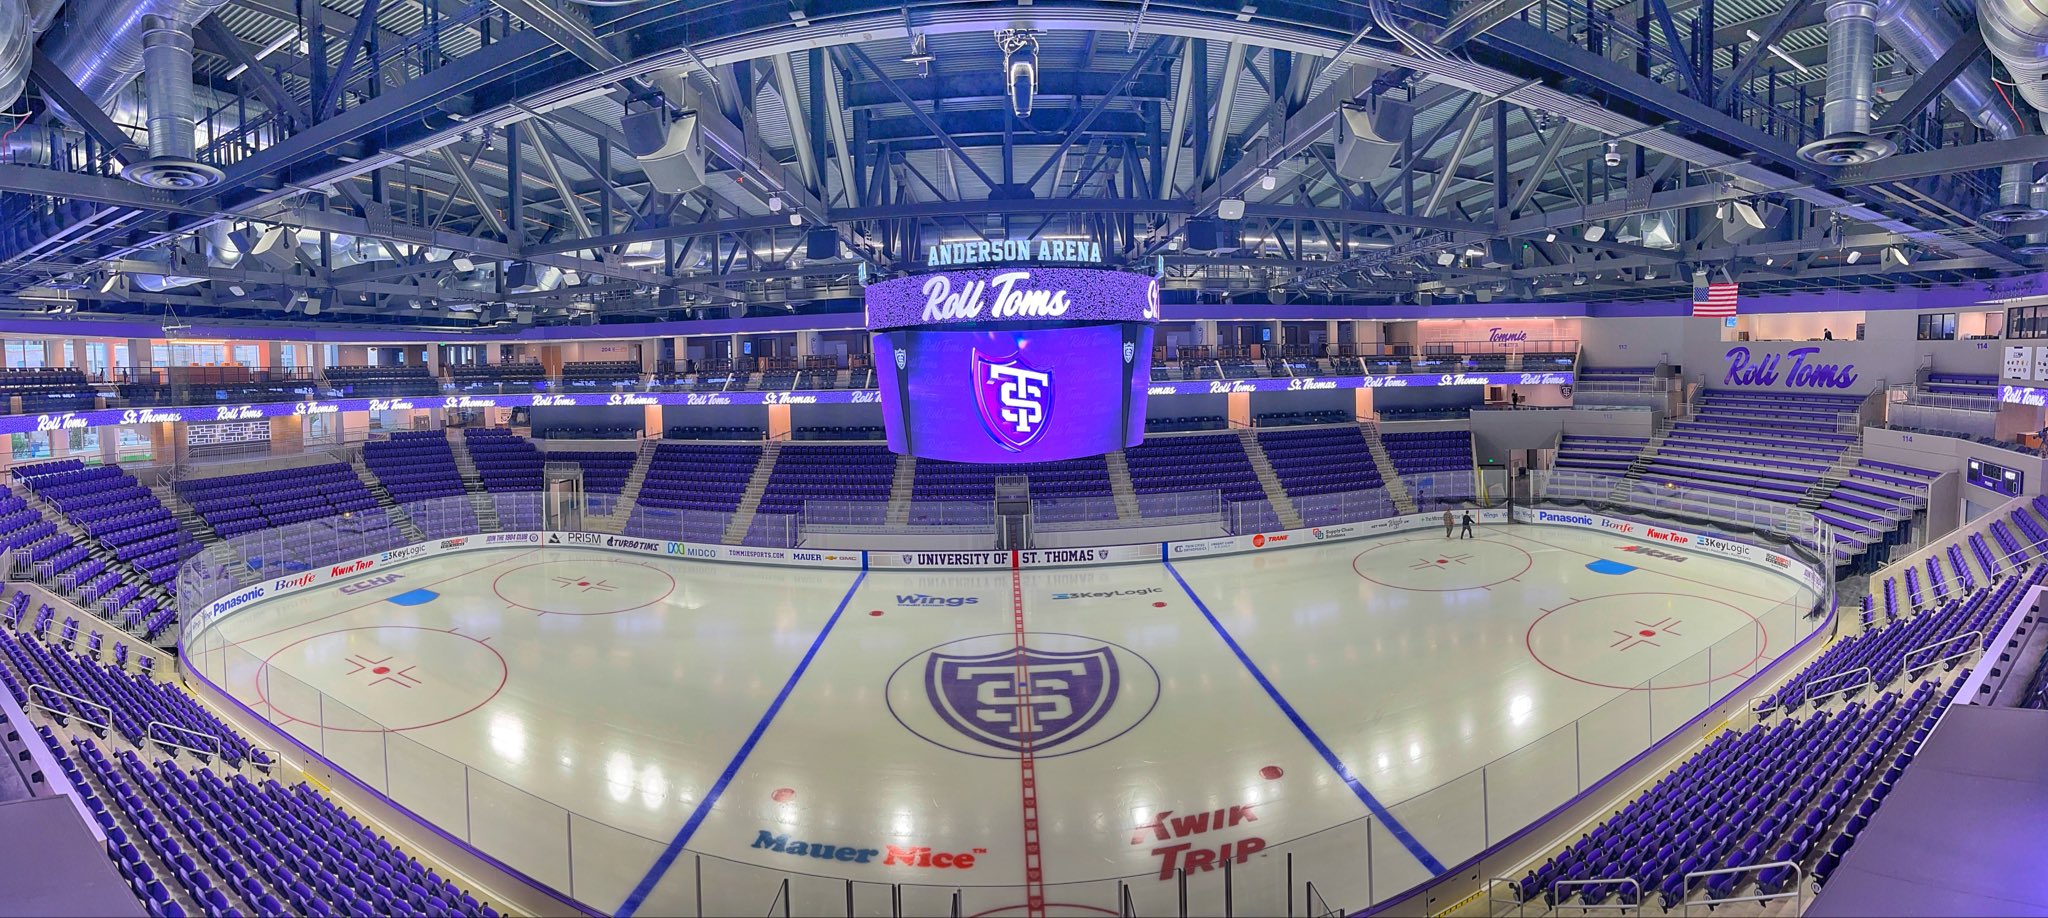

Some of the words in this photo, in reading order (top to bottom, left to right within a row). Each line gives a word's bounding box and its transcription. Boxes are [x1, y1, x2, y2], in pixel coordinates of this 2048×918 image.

[928, 240, 1031, 267] ANDERSON
[1038, 240, 1101, 263] ARENA
[922, 275, 985, 321] Roll
[991, 272, 1071, 318] Toms
[1490, 328, 1527, 342] Tommie
[1724, 347, 1780, 386] Roll
[1786, 347, 1858, 388] Toms
[1302, 378, 1337, 390] Thomas
[1364, 376, 1384, 387] Roll
[1384, 375, 1407, 387] Toms
[1452, 374, 1489, 385] Thomas
[1520, 374, 1540, 385] Roll
[1540, 373, 1565, 385] Toms
[1148, 385, 1176, 395] omas
[1210, 381, 1230, 393] Roll
[1231, 381, 1256, 393] Toms
[532, 395, 553, 406] Roll
[553, 395, 576, 406] Toms
[622, 393, 659, 405] Thomas
[688, 393, 707, 405] Roll
[707, 393, 731, 405] Toms
[777, 393, 817, 404] Thomas
[852, 391, 872, 403] Roll
[2003, 385, 2022, 403] Roll
[2022, 387, 2046, 406] Toms
[306, 402, 339, 414] Thomas
[369, 399, 389, 412] Roll
[390, 399, 414, 411] Toms
[459, 396, 496, 408] Thomas
[139, 408, 182, 423] Thomas
[217, 406, 238, 421] Roll
[239, 405, 263, 419] Toms
[37, 414, 61, 432] Roll
[62, 413, 88, 429] Toms
[1540, 512, 1592, 525] Panasonic
[1601, 518, 1634, 533] Bonfe
[568, 533, 601, 544] PRISM
[614, 539, 638, 549] TURBO
[1670, 532, 1688, 544] TRIP
[389, 544, 426, 560] 3KeyLogic
[1705, 538, 1749, 554] 3KeyLogic
[688, 548, 716, 558] MIDCO
[729, 550, 784, 559] TOMMIESPORTS.COM
[793, 553, 822, 561] MAUER
[917, 553, 989, 565] UNIVERSITY
[994, 553, 1009, 565] OF
[1022, 553, 1041, 564] ST.
[1045, 549, 1094, 563] THOMAS
[355, 560, 374, 571] TRIP
[274, 572, 316, 591] Bonfe
[339, 573, 405, 593] CCHA
[1070, 587, 1163, 599] 3KeyLogic
[214, 586, 265, 616] Panasonic
[896, 594, 979, 607] Wings
[1131, 805, 1257, 845] KWIK
[751, 830, 879, 864] Mauer
[1151, 837, 1266, 881] TRIP
